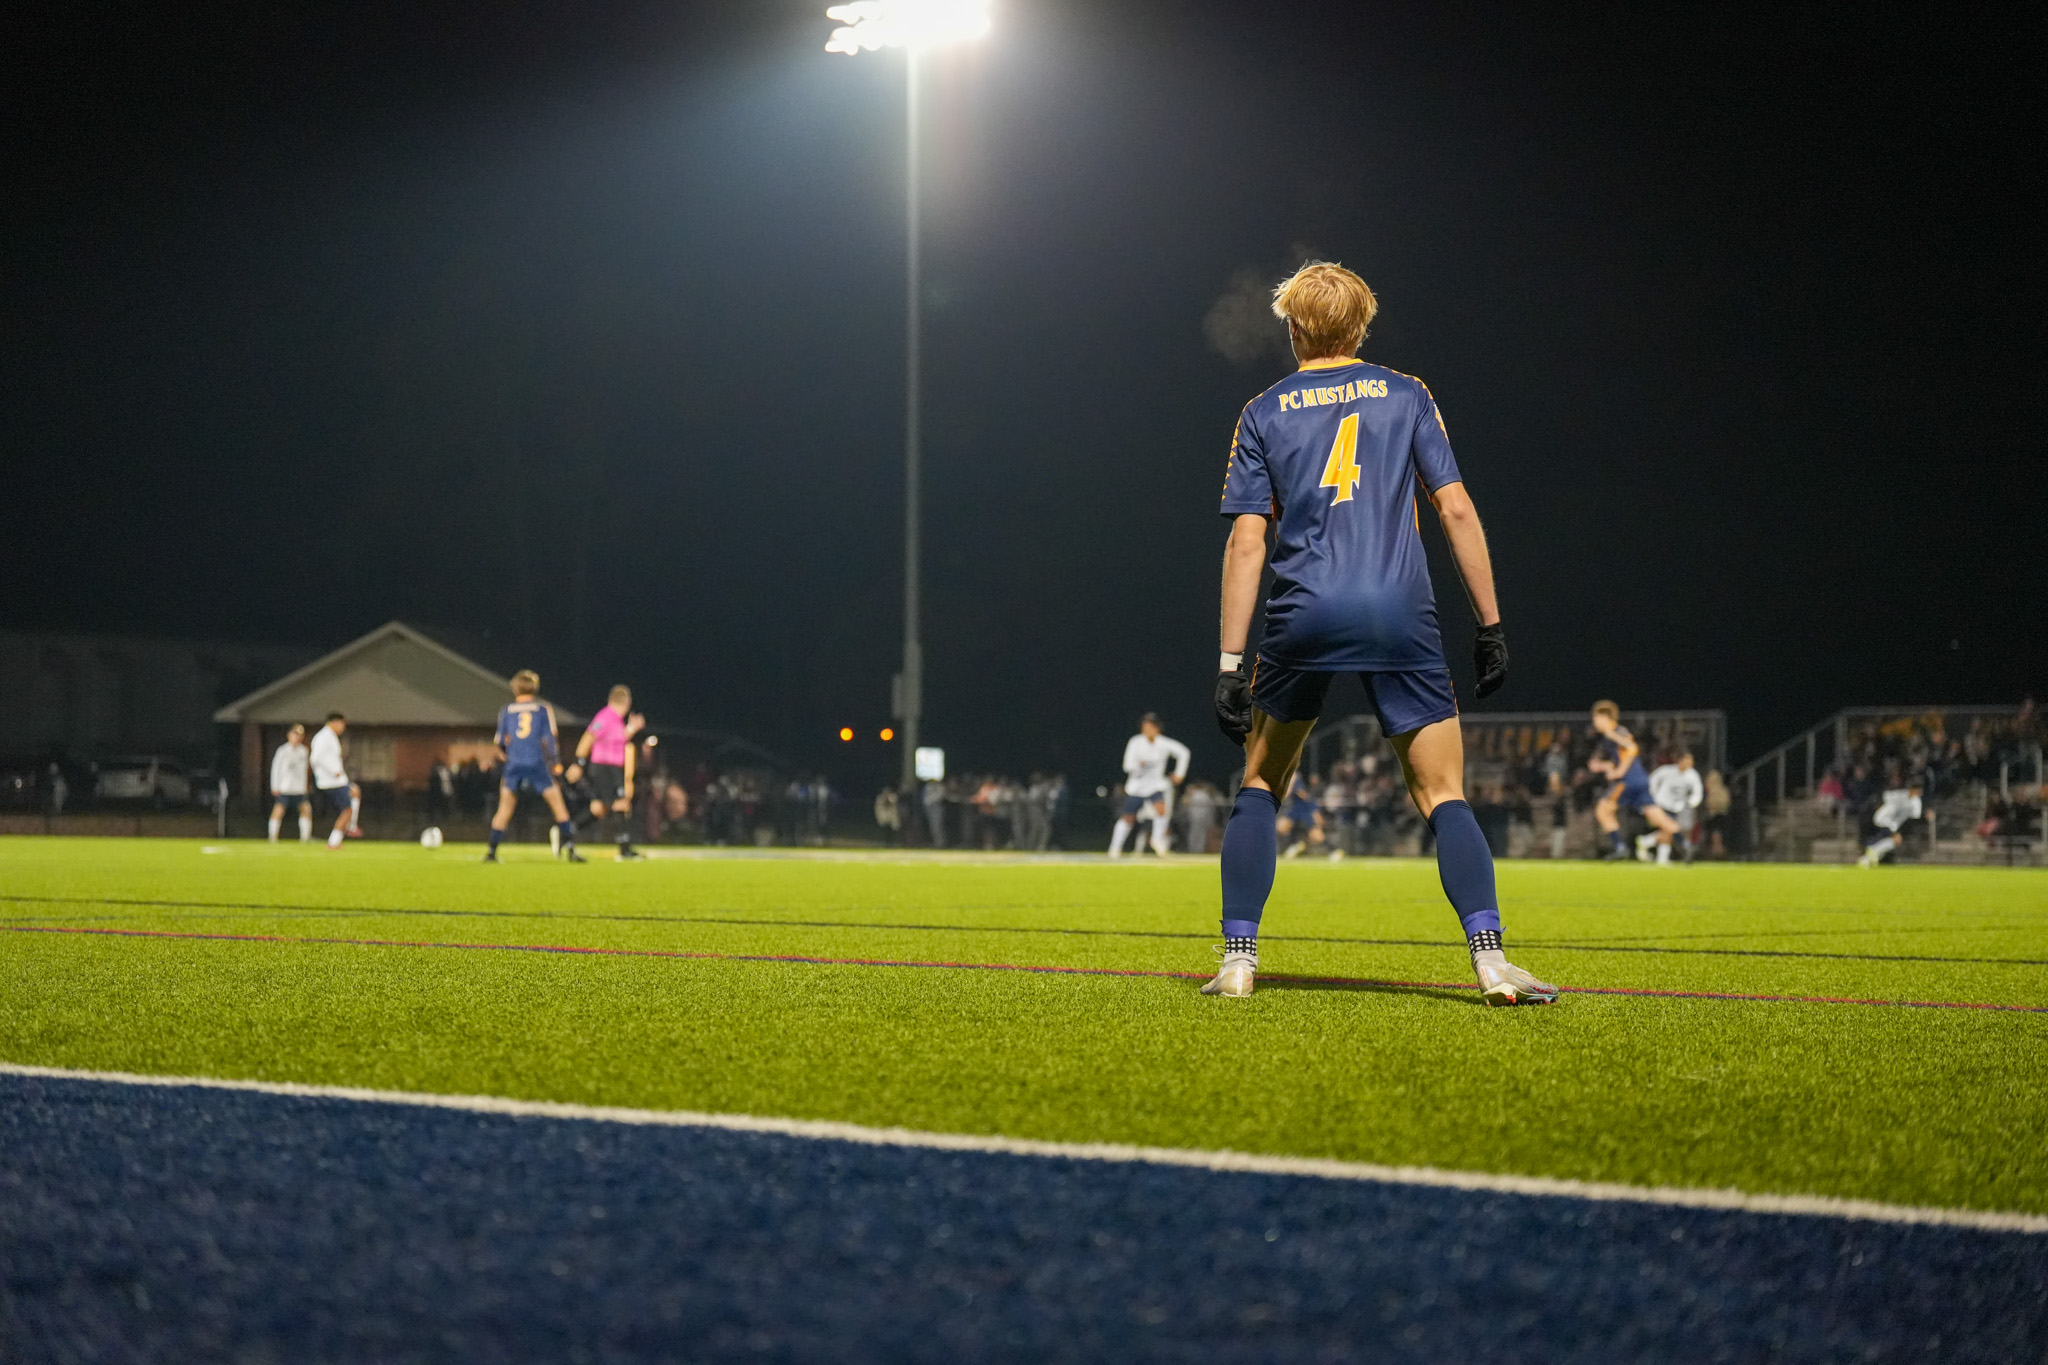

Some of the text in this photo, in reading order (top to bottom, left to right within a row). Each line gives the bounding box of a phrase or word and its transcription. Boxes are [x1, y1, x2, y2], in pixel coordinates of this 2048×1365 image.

[1278, 380, 1388, 412] PC MUSTANGS
[1319, 413, 1361, 506] 4
[516, 711, 532, 739] 3
